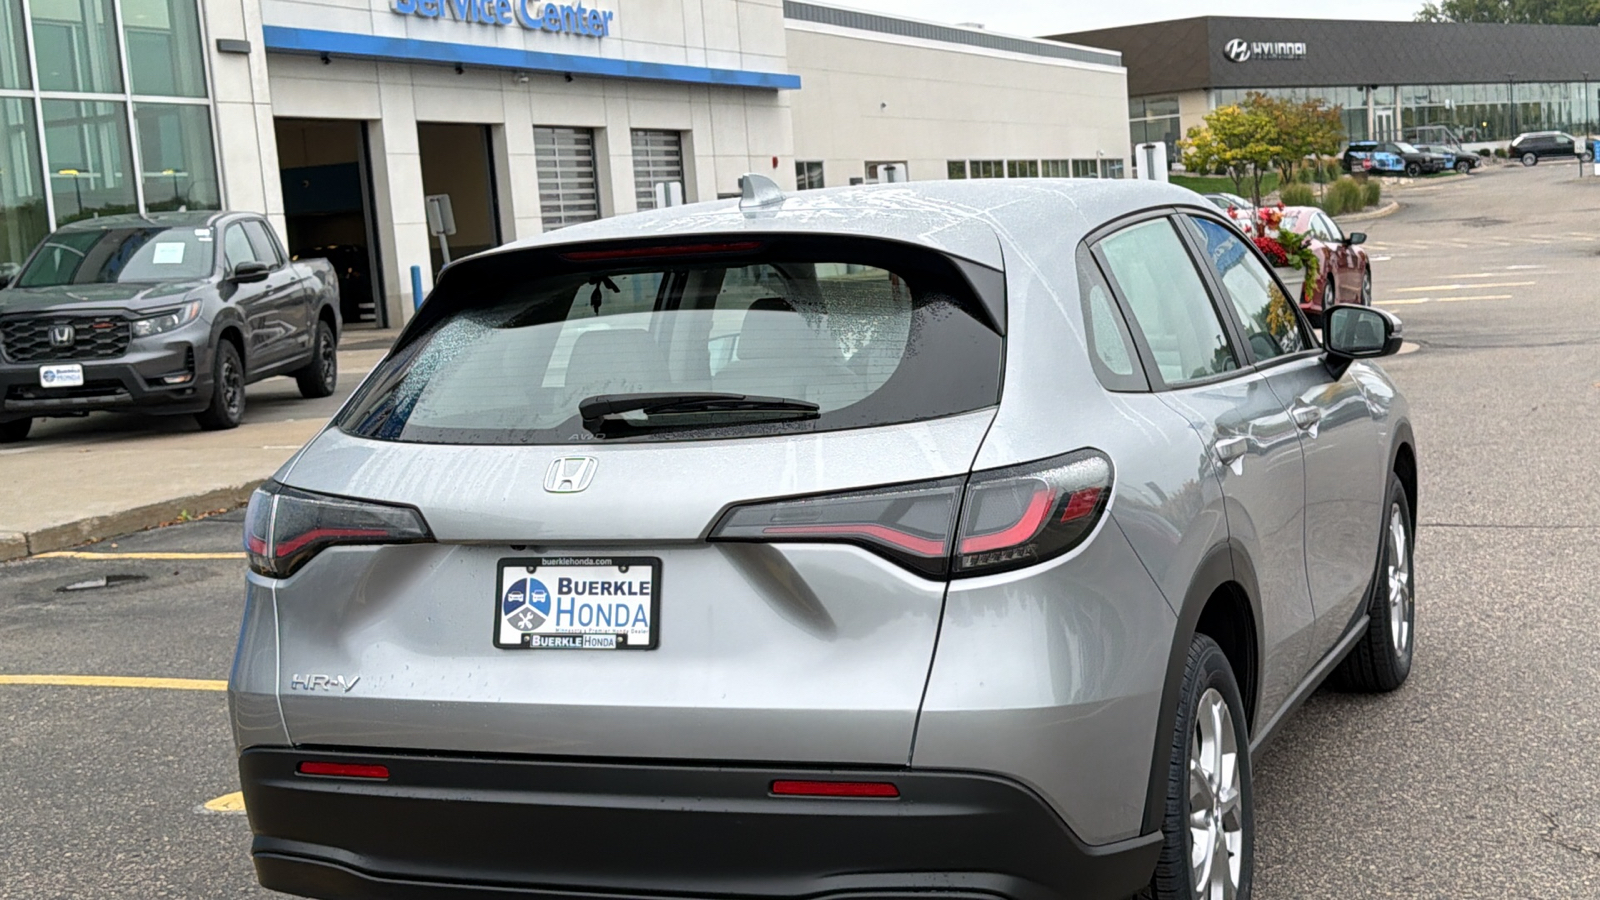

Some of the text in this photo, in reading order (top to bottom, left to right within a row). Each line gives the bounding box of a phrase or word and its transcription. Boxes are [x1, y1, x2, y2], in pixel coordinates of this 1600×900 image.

[514, 0, 613, 37] Center
[1251, 42, 1306, 56] HYUNDAI
[542, 558, 612, 566] buerklehonda.com
[557, 577, 650, 596] BUERKLE
[556, 597, 648, 628] HONDA
[532, 635, 614, 647] BUERKLE HONDA
[291, 673, 360, 693] HR-V
